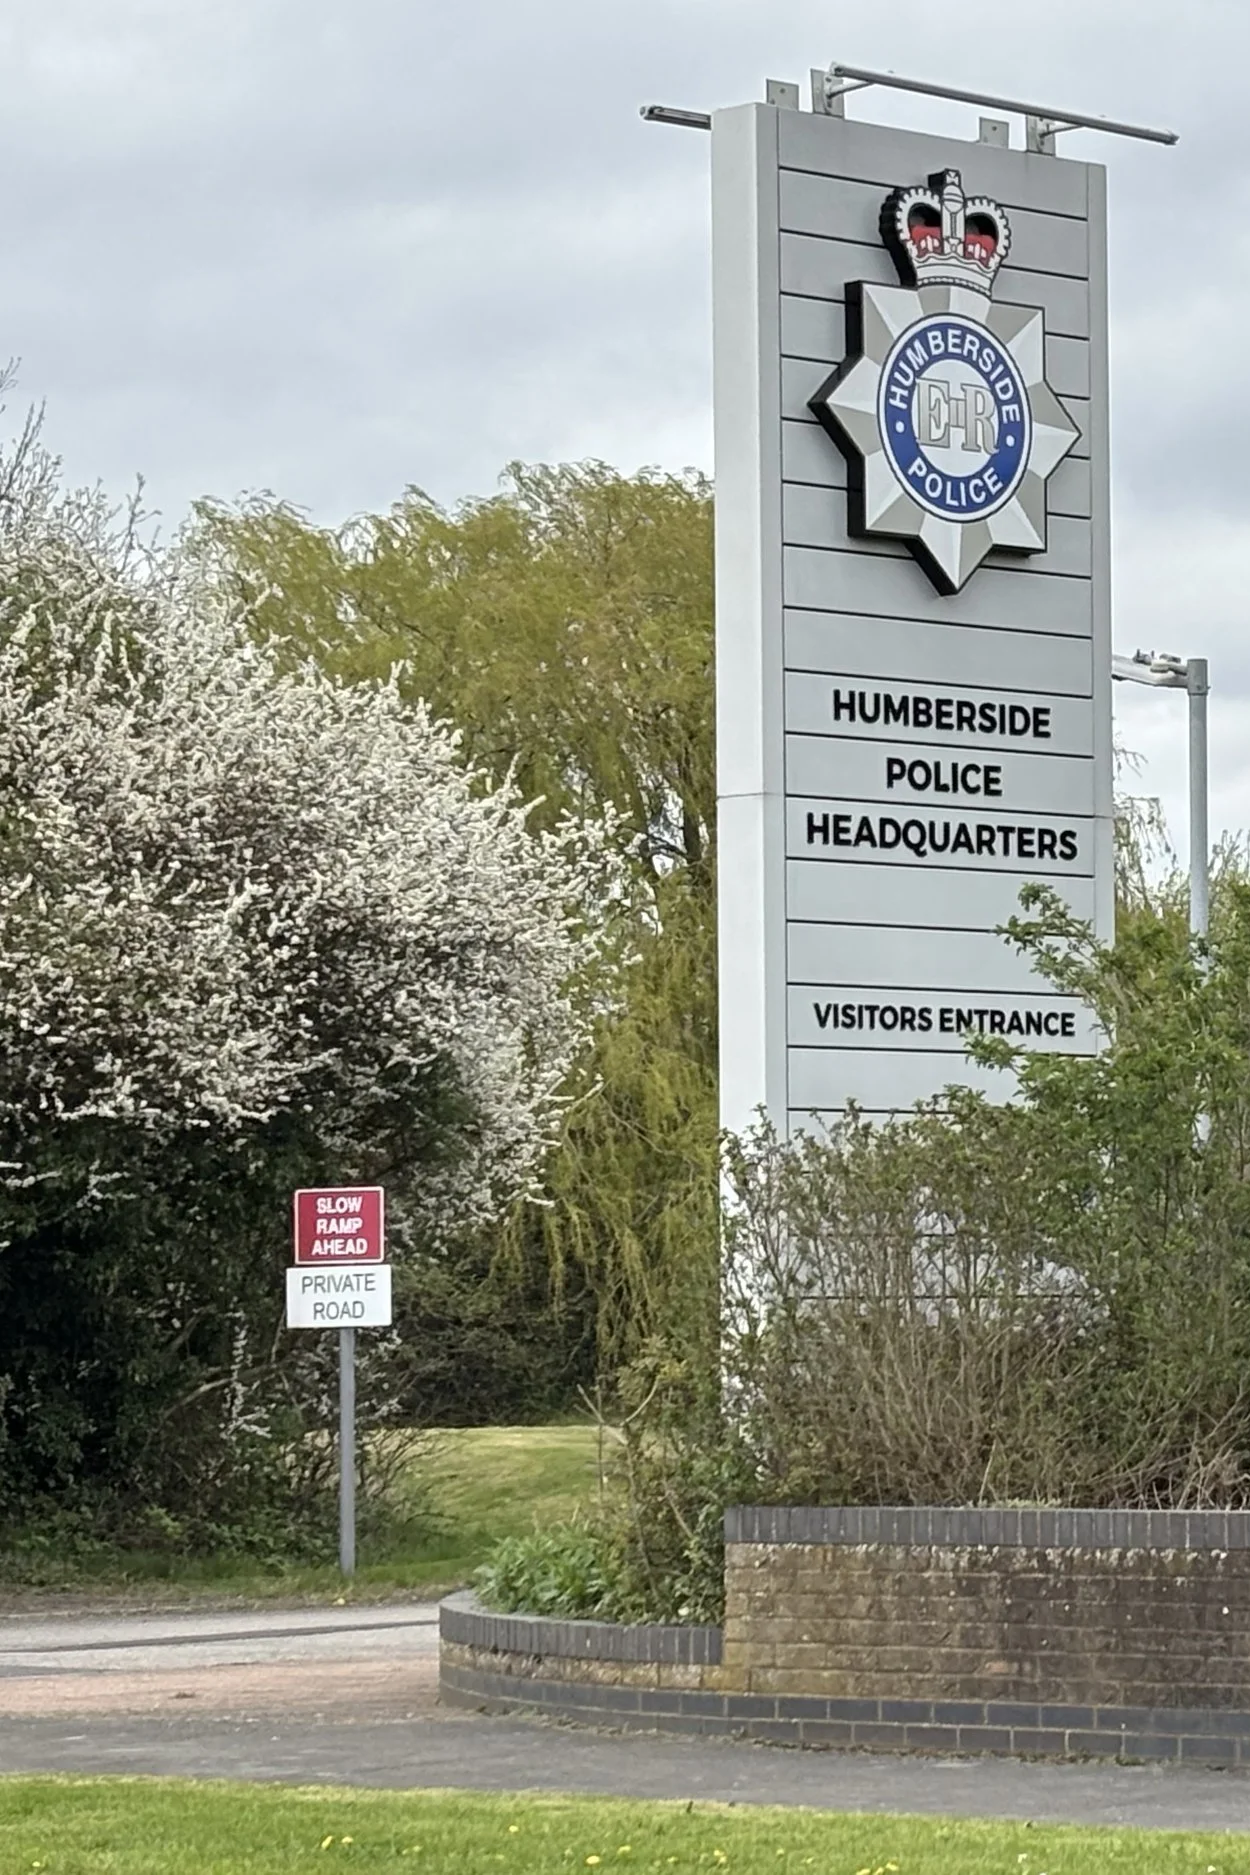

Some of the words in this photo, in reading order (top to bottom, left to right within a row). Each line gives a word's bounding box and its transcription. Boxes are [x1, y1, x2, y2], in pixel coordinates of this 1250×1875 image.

[889, 328, 1021, 424] HUMBERSIDE
[907, 456, 1003, 507] POLICE
[832, 688, 1051, 738] HUMBERSIDE
[886, 757, 1003, 797] POLICE
[806, 811, 1078, 860] HEADQUARTERS
[813, 1002, 933, 1033] VISITORS
[938, 1007, 1076, 1037] ENTRANCE
[316, 1196, 362, 1214] SLOW
[316, 1217, 363, 1235] RAMP
[311, 1238, 368, 1256] AHEAD
[301, 1273, 376, 1295] PRIVATE
[313, 1300, 365, 1321] ROAD
